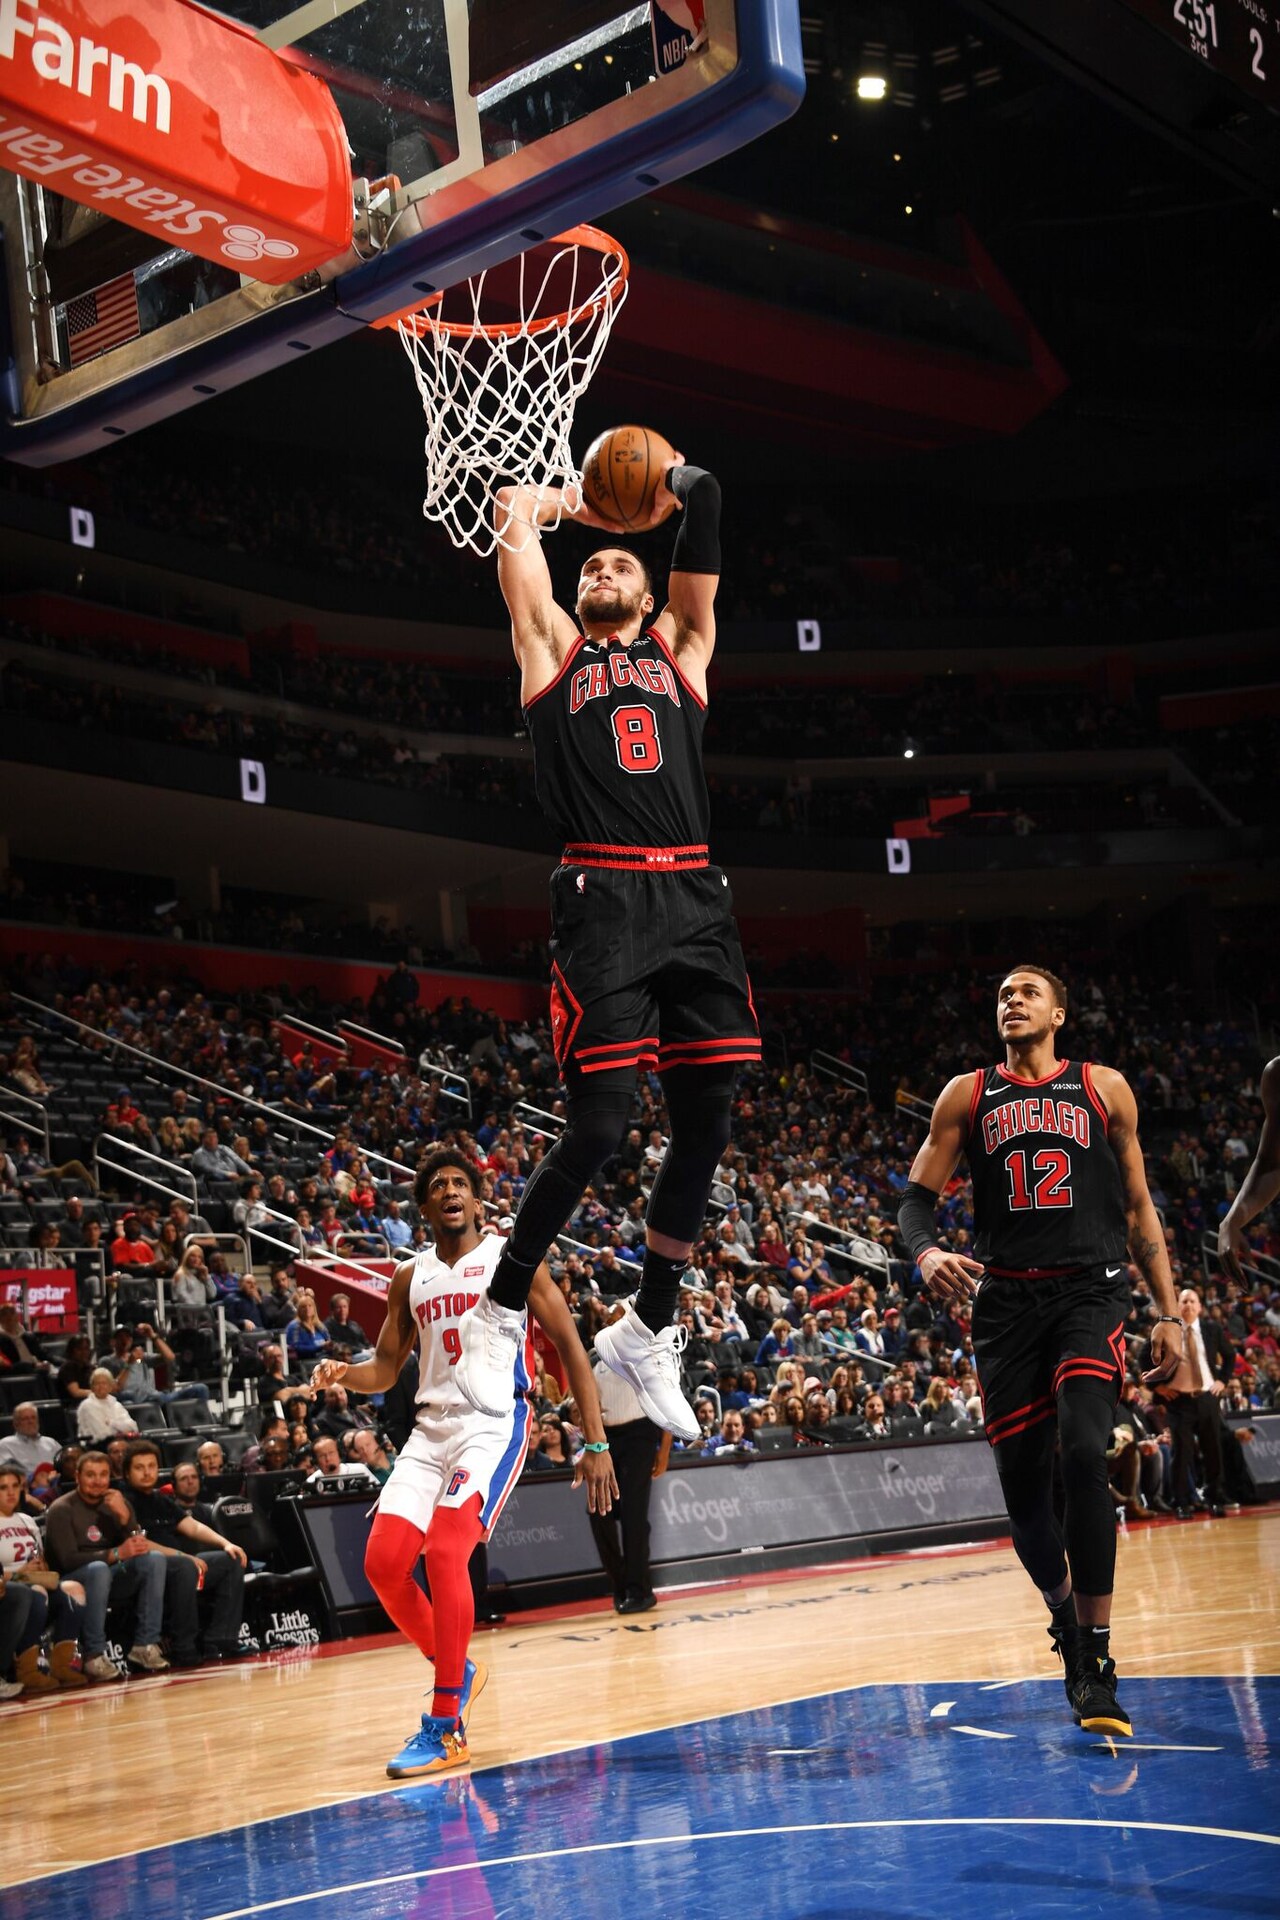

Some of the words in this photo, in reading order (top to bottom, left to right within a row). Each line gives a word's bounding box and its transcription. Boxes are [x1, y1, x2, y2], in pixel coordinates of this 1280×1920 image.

[0, 0, 171, 135] Farm
[662, 34, 690, 68] NBA
[1189, 32, 1208, 59] 3rd
[1249, 27, 1266, 81] 2
[70, 506, 95, 549] D
[797, 619, 821, 651] D
[569, 652, 682, 715] CHCAGO
[610, 703, 663, 775] 8
[240, 758, 266, 804] D
[885, 838, 911, 874] D
[981, 1098, 1090, 1155] CHICAGO
[1004, 1148, 1073, 1212] 12
[416, 1292, 481, 1330] PISTON
[442, 1328, 463, 1366] 9
[878, 1456, 947, 1516] Kroger
[660, 1478, 742, 1543] Kroger
[265, 1627, 320, 1646] Caesars
[271, 1609, 311, 1633] Little
